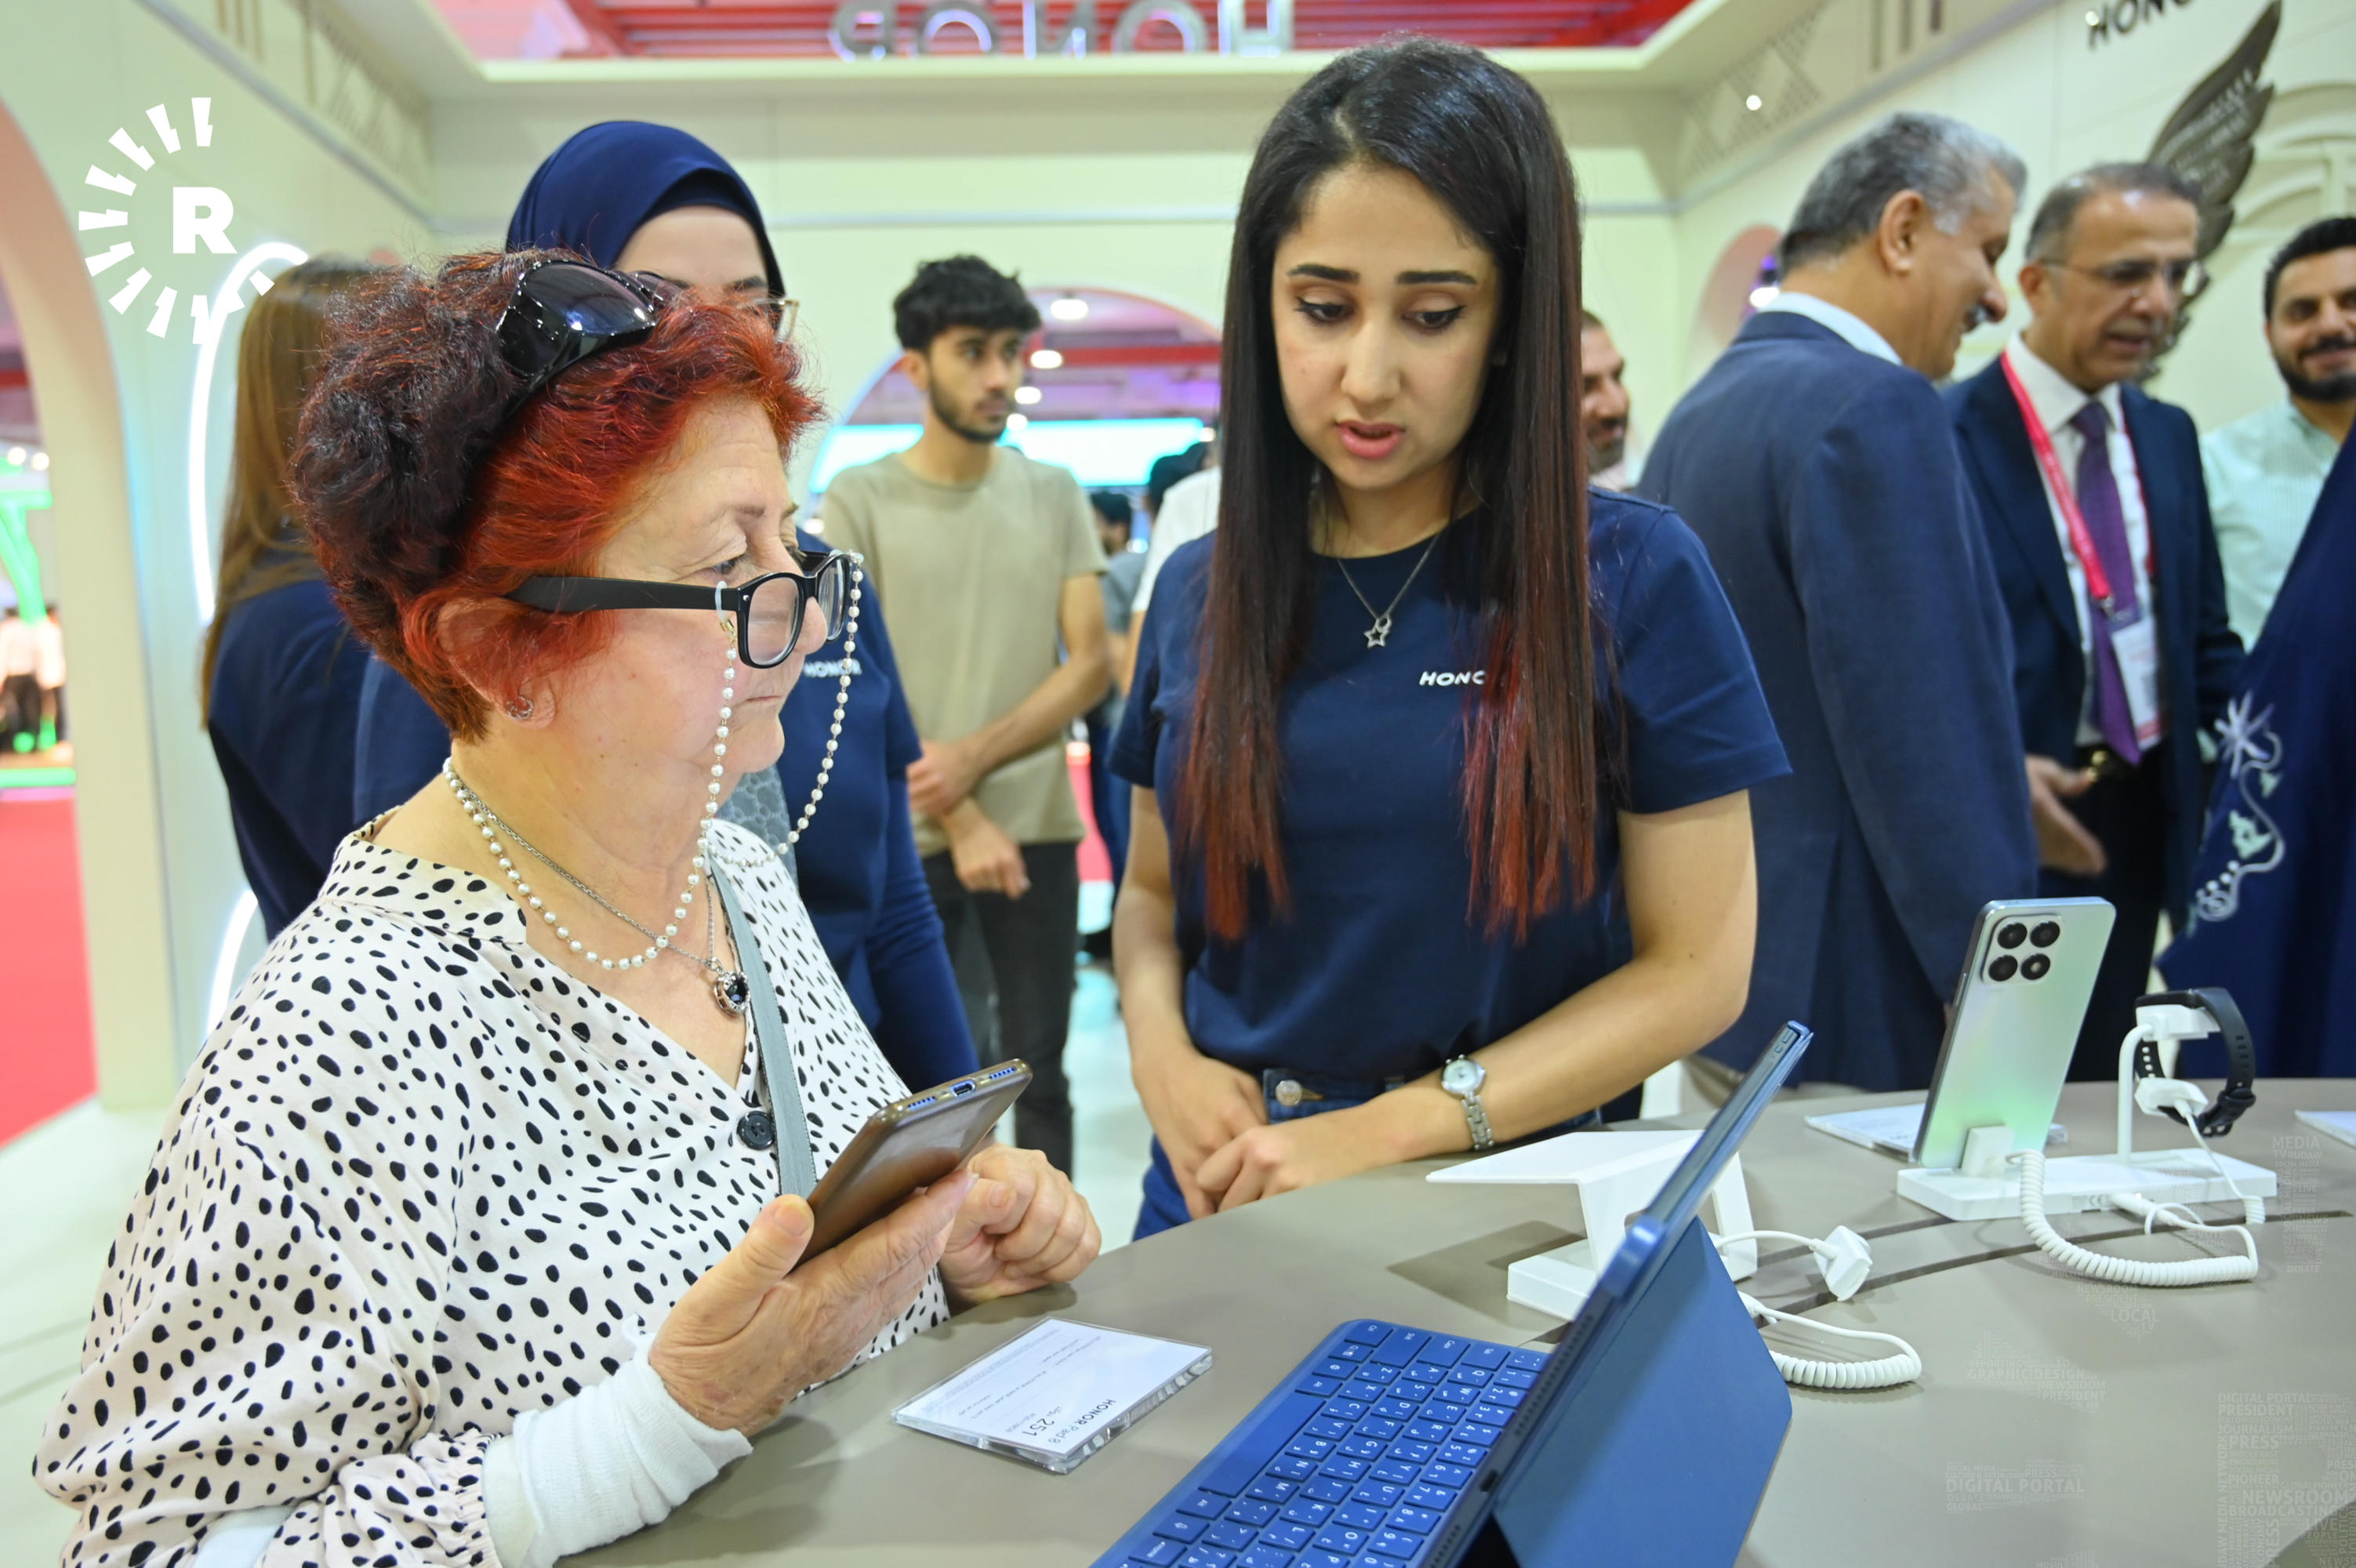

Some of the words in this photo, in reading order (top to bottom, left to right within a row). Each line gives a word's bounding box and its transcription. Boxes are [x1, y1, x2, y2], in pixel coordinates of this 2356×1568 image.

[1073, 1399, 1116, 1425] HONOR
[1022, 1417, 1055, 1436] 251
[1056, 1425, 1080, 1438] Pad
